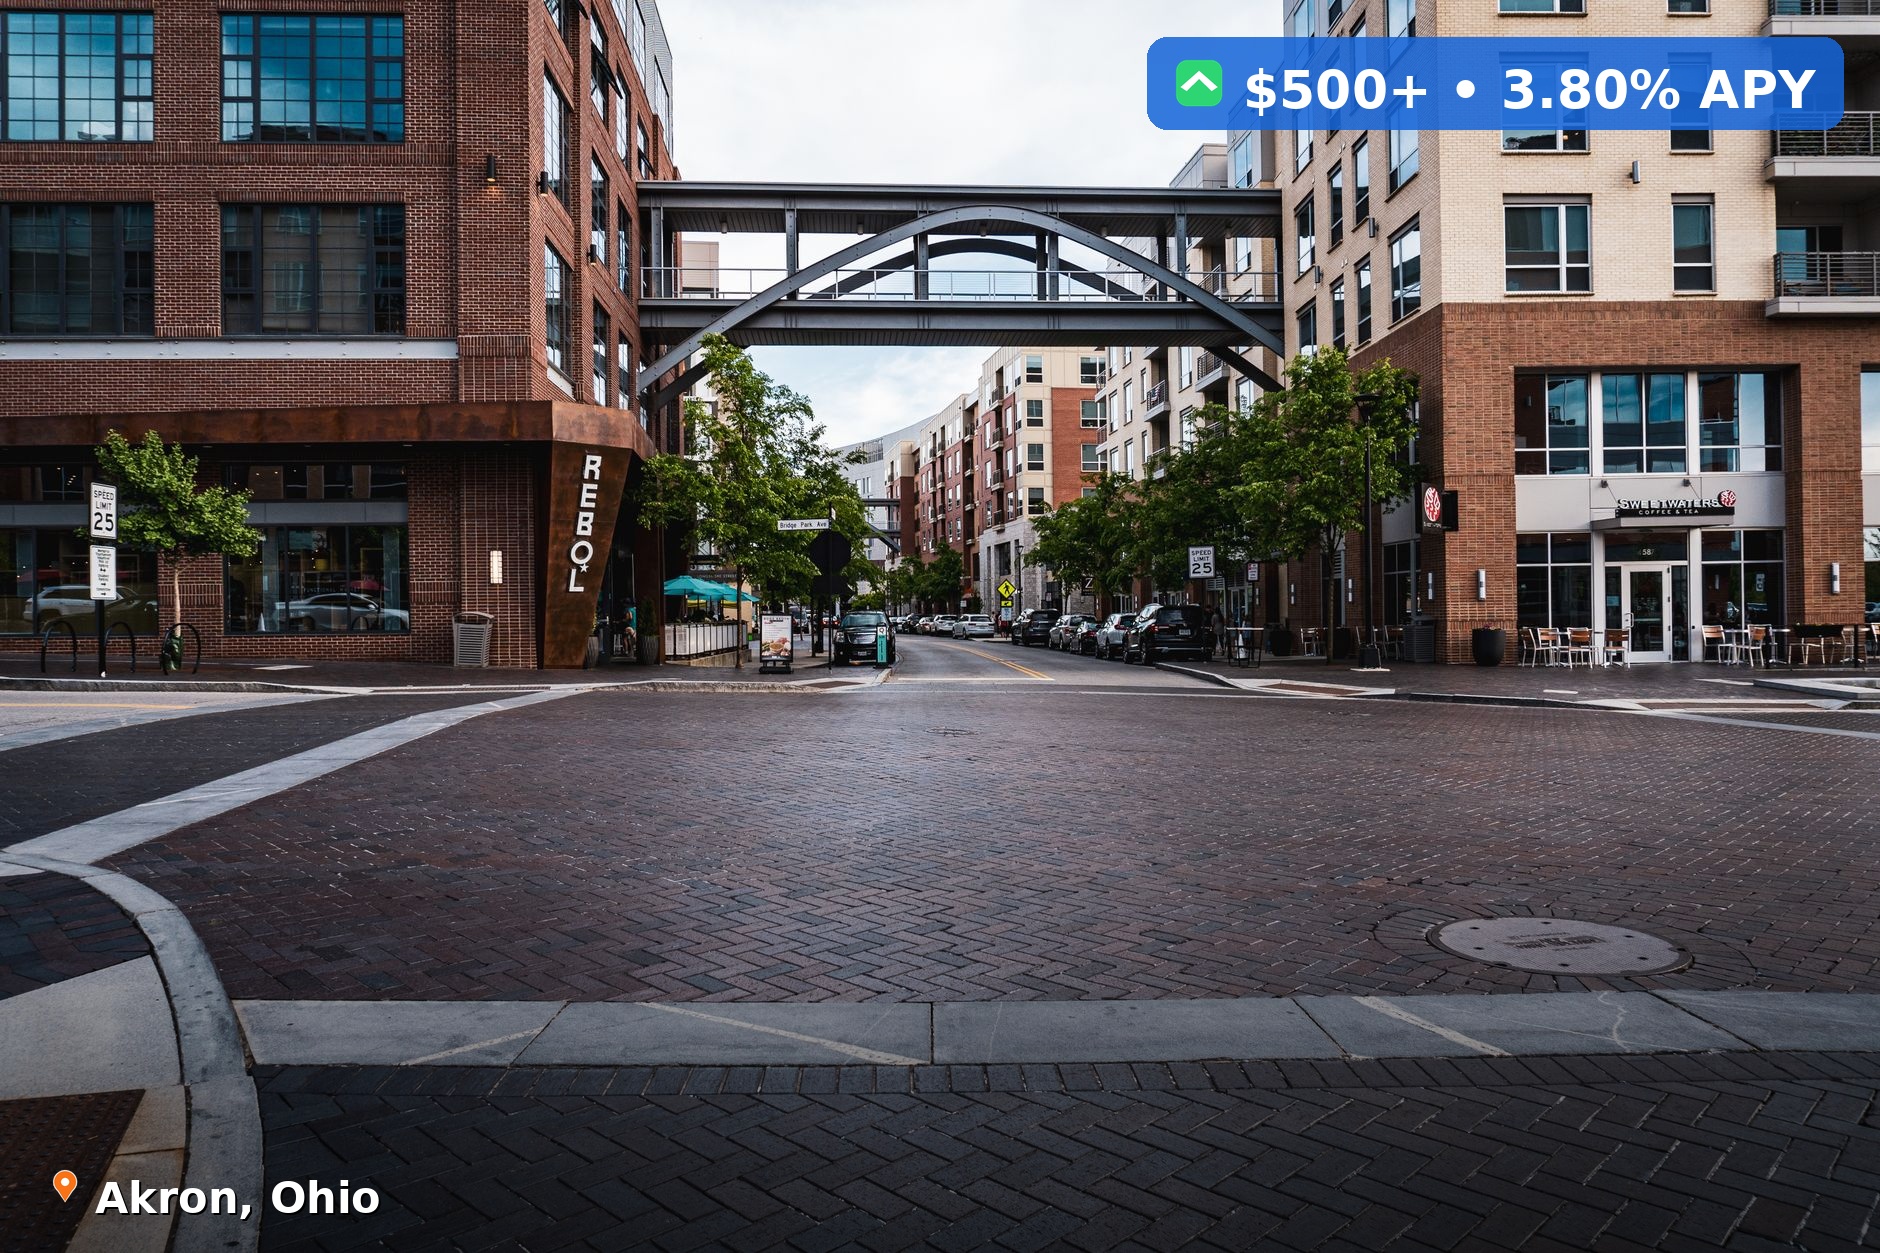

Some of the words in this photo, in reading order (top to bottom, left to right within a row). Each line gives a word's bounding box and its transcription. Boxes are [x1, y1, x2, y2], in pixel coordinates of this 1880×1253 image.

[94, 490, 114, 500] SPEED
[95, 501, 112, 510] LIMIT
[1619, 498, 1723, 509] SWEETWATERS
[94, 512, 114, 531] 25
[569, 454, 602, 592] REBOL
[1192, 563, 1212, 574] 25
